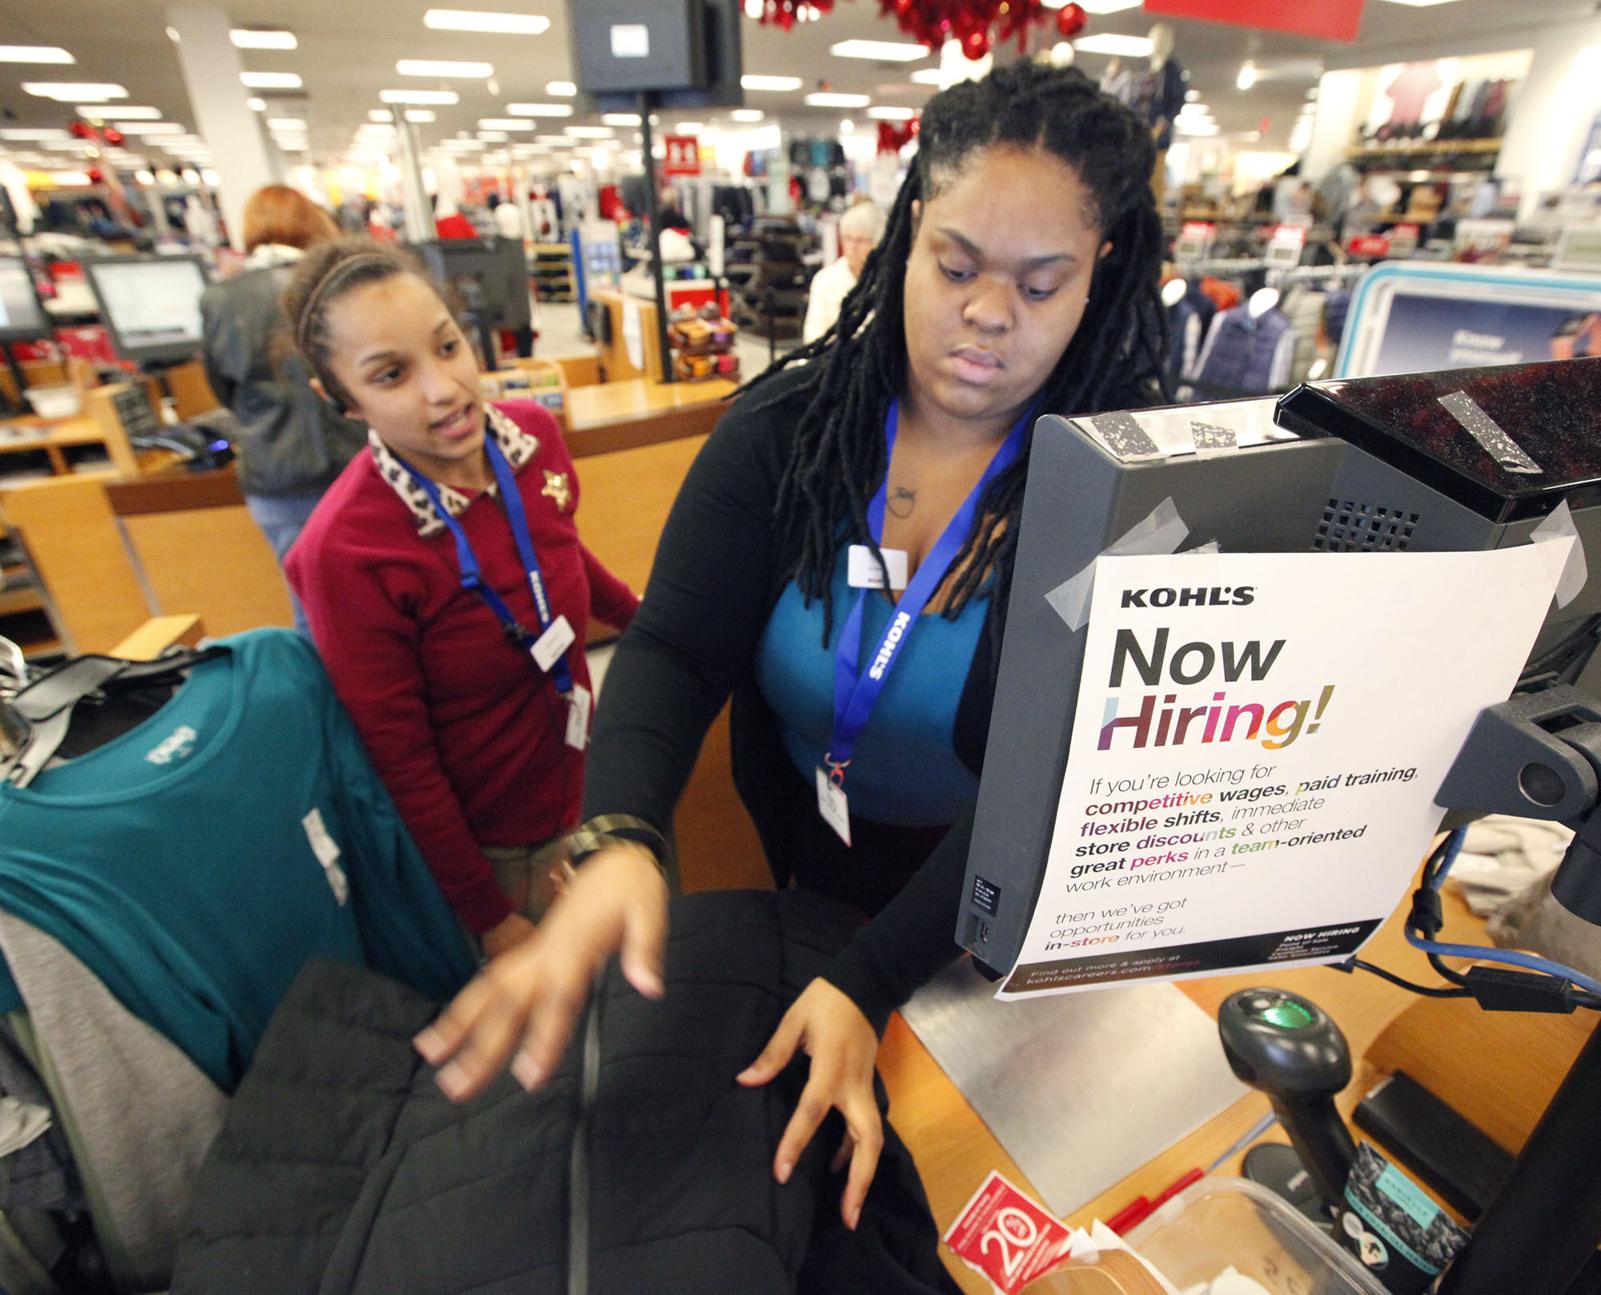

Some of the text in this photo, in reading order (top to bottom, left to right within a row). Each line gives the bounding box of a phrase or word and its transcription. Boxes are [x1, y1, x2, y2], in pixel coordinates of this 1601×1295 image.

[1120, 586, 1256, 608] KOHL'S
[869, 610, 911, 681] KOHL'S
[1108, 627, 1287, 688] Now
[1097, 685, 1335, 751] Hiring!
[1085, 766, 1418, 816] competitive wages, paid training,
[1090, 764, 1277, 798] If you're looking for
[1080, 797, 1325, 837] flexible shifts, immediate
[1070, 825, 1368, 879] great perks in a team-oriented
[1075, 817, 1307, 858] store discounts & other
[1066, 876, 1112, 893] work
[1049, 915, 1165, 939] opportunities
[1056, 898, 1188, 924] then we've got
[1044, 926, 1186, 951] in-store for you.
[1284, 927, 1360, 943] NOW HIRING
[1031, 969, 1058, 977] Find
[1085, 963, 1117, 971] more
[981, 1207, 1038, 1277] 20
